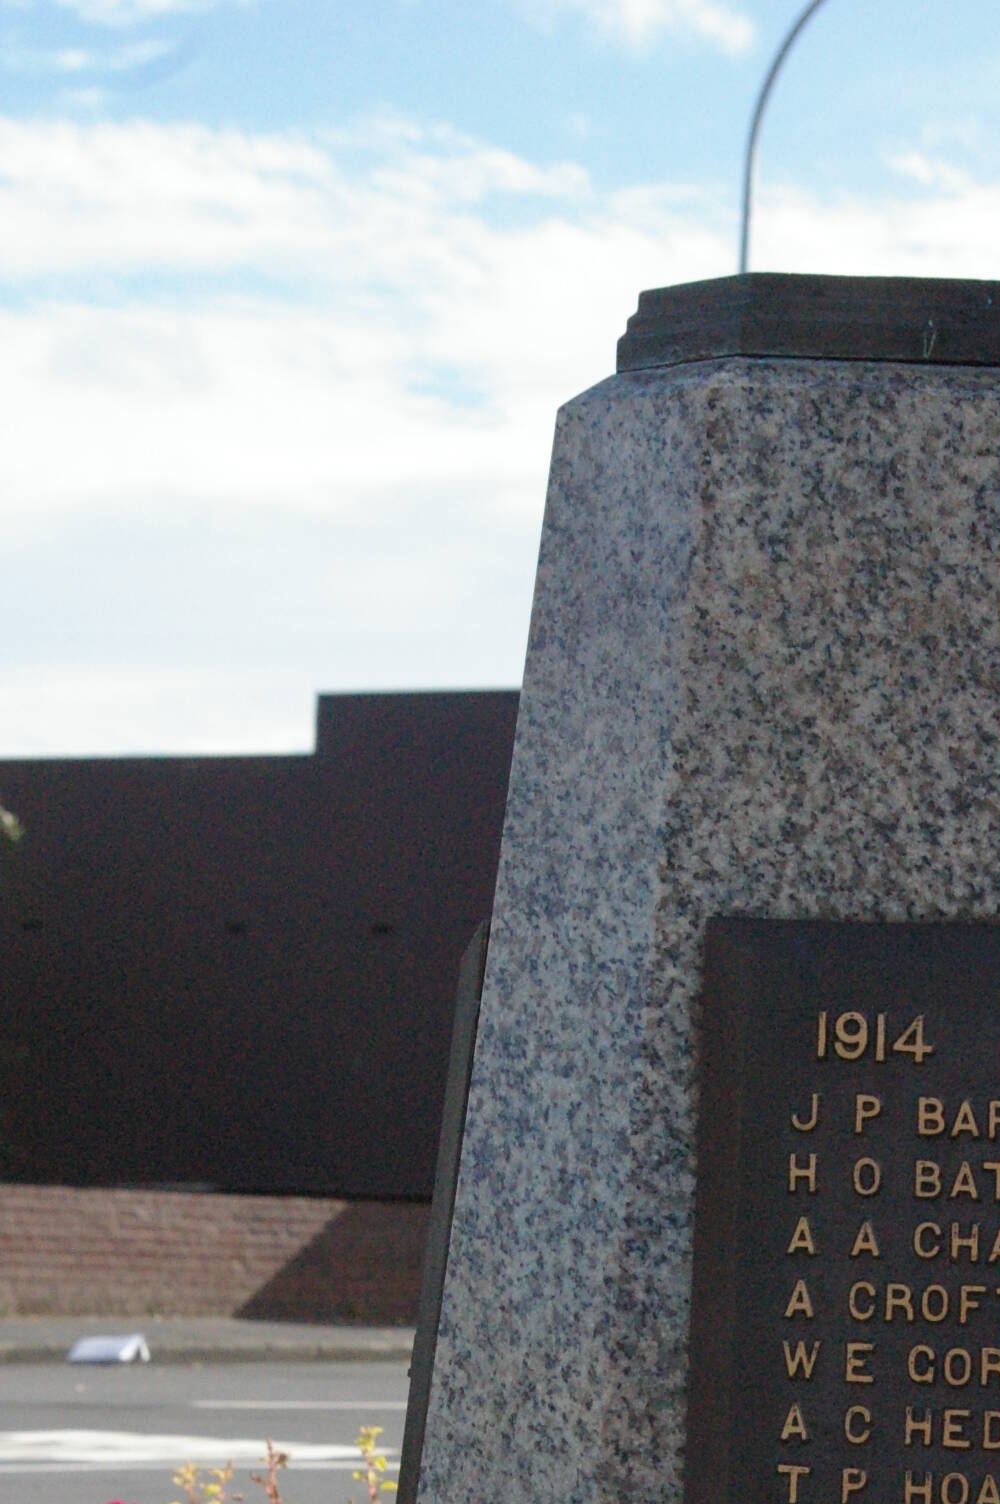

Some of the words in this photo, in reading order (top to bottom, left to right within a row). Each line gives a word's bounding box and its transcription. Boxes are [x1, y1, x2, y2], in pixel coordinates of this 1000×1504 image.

[815, 1011, 934, 1063] 1914
[789, 1093, 820, 1132] J
[853, 1094, 882, 1133] P
[788, 1153, 817, 1192] H
[852, 1157, 881, 1195] O
[786, 1217, 815, 1254] A
[851, 1222, 879, 1256] A
[784, 1280, 813, 1317] A
[782, 1340, 820, 1378] W
[844, 1342, 875, 1383] E
[780, 1404, 808, 1439] A
[844, 1406, 871, 1443] C
[777, 1464, 810, 1504] T
